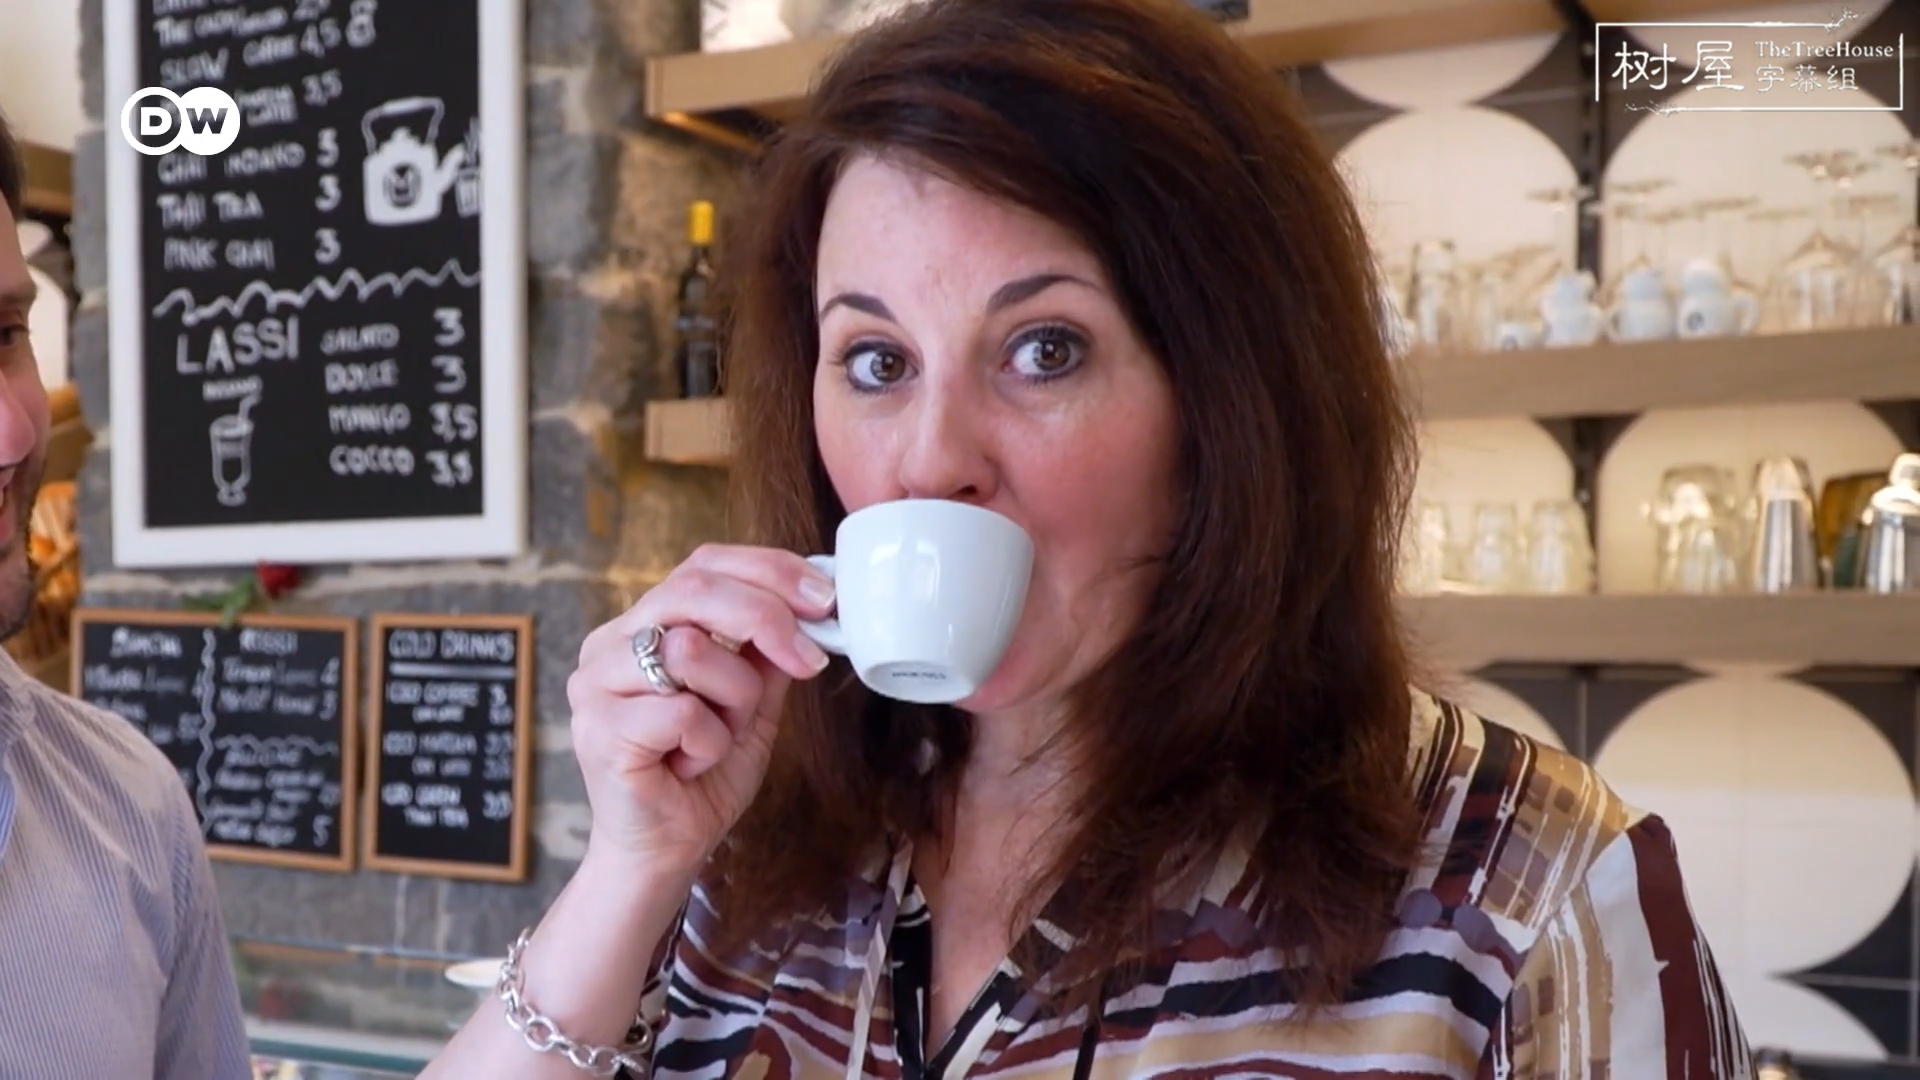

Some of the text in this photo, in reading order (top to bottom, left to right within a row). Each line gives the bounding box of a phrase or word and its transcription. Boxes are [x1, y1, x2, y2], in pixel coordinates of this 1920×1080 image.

[161, 49, 228, 87] SLOW
[318, 129, 338, 166] 3
[316, 175, 340, 210] 3
[316, 229, 340, 263] 3
[177, 313, 298, 373] LASSI
[434, 308, 464, 345] 3
[325, 356, 466, 393] DOLCE 3
[329, 403, 477, 441] MANGO 3,5
[330, 445, 414, 475] COCCO
[441, 628, 514, 661] DRINKS
